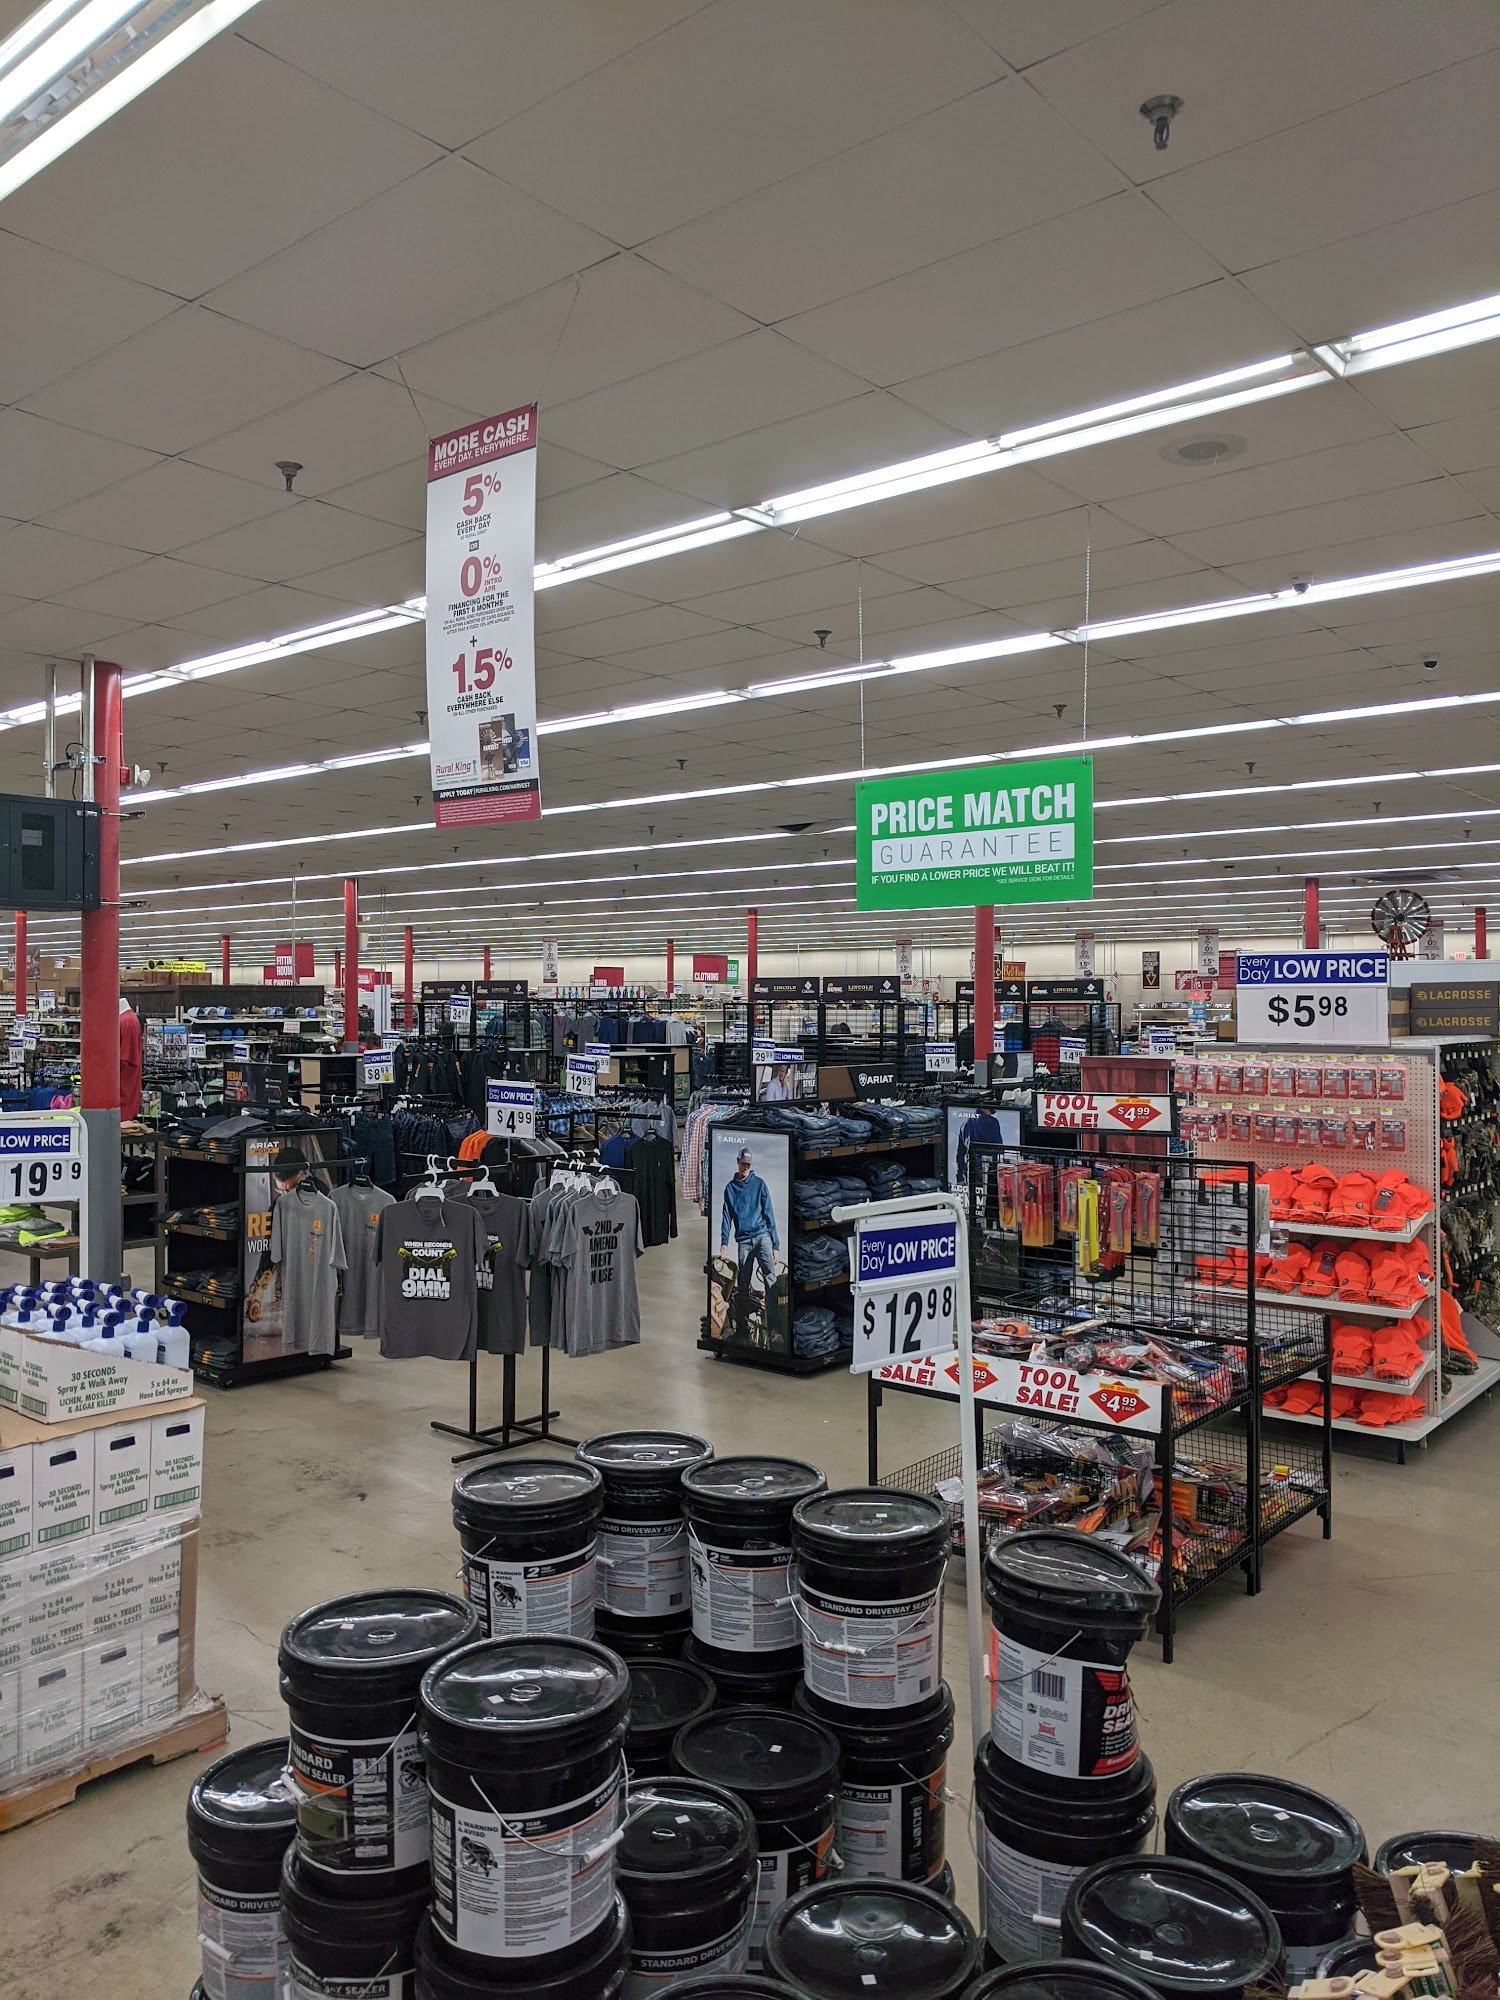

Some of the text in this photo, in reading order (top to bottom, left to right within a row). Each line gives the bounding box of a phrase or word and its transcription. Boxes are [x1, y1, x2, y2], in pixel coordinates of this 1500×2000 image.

[434, 413, 530, 461] MORE CASH
[434, 433, 529, 472] EVERY DAY. EVERYWHERE.
[462, 472, 501, 516] 5%
[456, 513, 492, 529] CASH BACK
[457, 521, 491, 536] EVERY DAY
[460, 554, 501, 597] 0%
[484, 577, 502, 586] INTRO
[484, 585, 496, 593] APR
[448, 591, 509, 611] FINANCING FOR THE
[453, 599, 504, 617] FIRST 6 MONTHS
[447, 696, 504, 713] EVERYWHERE ELSE
[457, 691, 492, 704] CASH BACK
[436, 762, 471, 774] Rural King
[440, 790, 456, 798] APPLY
[871, 782, 1075, 836] PRICE MATCH
[880, 831, 1063, 865] GUARANTEE
[872, 862, 1074, 884] IF YOU FIND A LOWER PRICE WE WILL BEAT IT!
[1239, 956, 1271, 969] Every
[1274, 958, 1386, 979] LOW PRICE
[694, 972, 719, 981] CLOTHING
[1239, 968, 1271, 983] Day
[1430, 990, 1491, 999] LACROSSE
[1430, 1017, 1491, 1026] LACROSSE
[867, 1075, 894, 1084] ARIAT
[501, 1091, 534, 1101] LOW PRICE
[1044, 1095, 1098, 1110] TOOL
[1044, 1112, 1099, 1127] SALE!
[0, 1135, 69, 1147] LOW PRICE
[250, 1141, 279, 1149] ARIAT
[722, 1136, 747, 1144] ARIAT
[595, 1220, 611, 1235] 2ND
[248, 1239, 271, 1253] WOR
[589, 1236, 617, 1252] AMEND
[862, 1240, 886, 1254] Every
[888, 1236, 954, 1265] LOW PRICE
[412, 1249, 444, 1257] COUNT
[591, 1252, 613, 1268] MENT
[862, 1255, 885, 1272] Day
[409, 1268, 446, 1281] DIAL
[599, 1268, 613, 1283] USE
[402, 1279, 450, 1298] 9MM
[71, 1366, 116, 1382] 30 SECONDS
[880, 1364, 936, 1386] SALE!
[1019, 1365, 1080, 1392] TOOL
[57, 1382, 78, 1395] Spray
[88, 1377, 107, 1389] Walk
[108, 1375, 128, 1386] Away
[139, 1385, 189, 1400] Hose End Sprayer
[60, 1388, 125, 1407] LICHEN, MOSS, MOLD
[75, 1403, 95, 1412] ALGAE
[97, 1398, 117, 1408] KILLER
[1016, 1386, 1080, 1413] SALE!
[155, 1467, 170, 1476] Spray
[177, 1463, 188, 1471] Walk
[189, 1460, 200, 1469] Away
[165, 1455, 194, 1467] 30 SECONDS
[621, 1526, 663, 1534] DRIVEWAY
[709, 1551, 720, 1563] 2
[526, 1567, 539, 1578] 2
[92, 1583, 144, 1603] Hose End Sprayer
[151, 1594, 166, 1605] KILLS
[94, 1604, 142, 1626] KILLS TREATS
[150, 1602, 172, 1614] CLEANS
[820, 1600, 863, 1615] STANDARD
[866, 1606, 910, 1615] DRIVEWAY
[124, 1614, 142, 1625] LASTS
[311, 1768, 346, 1784] SEALER
[856, 1791, 889, 1800] SEALER
[464, 1821, 499, 1833] WARNING
[464, 1828, 486, 1838] AVISO
[505, 1822, 525, 1836] 2
[240, 1900, 280, 1909] DRIVEW
[640, 1933, 740, 1968] STANDARD DRIVEWAY
